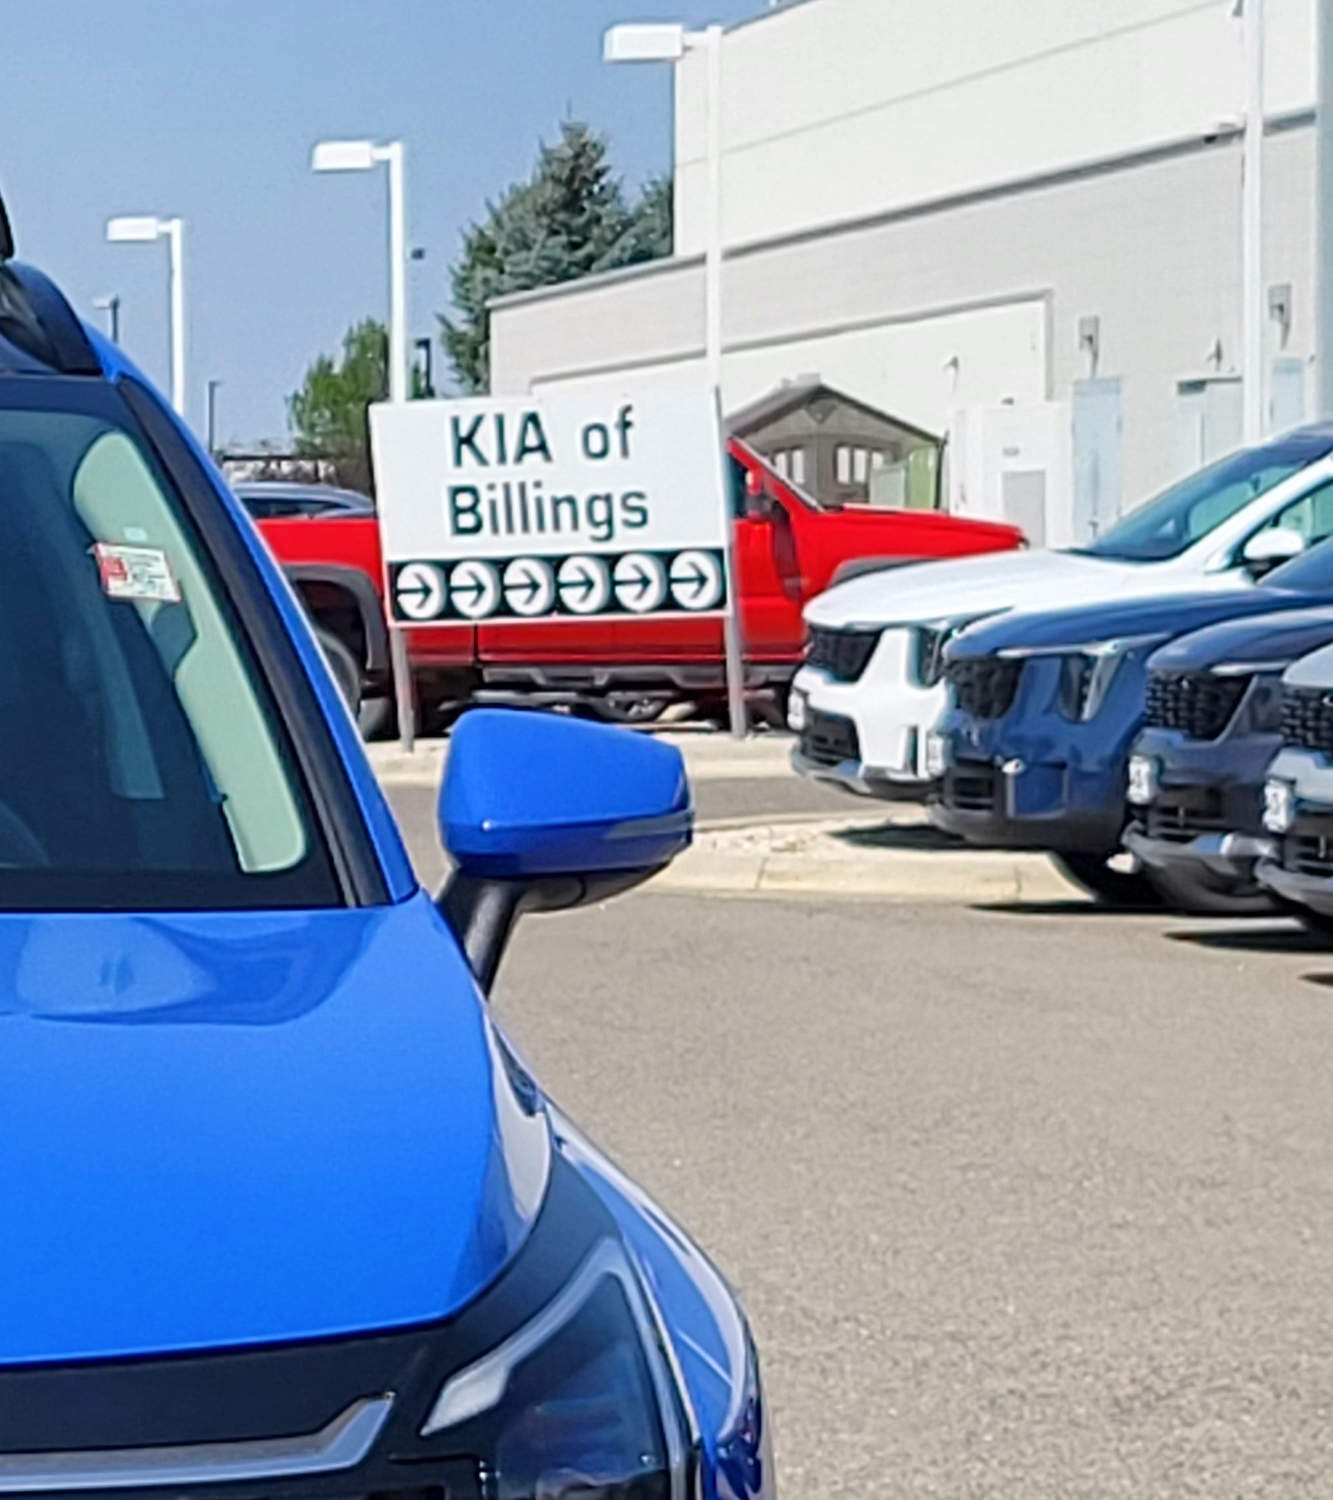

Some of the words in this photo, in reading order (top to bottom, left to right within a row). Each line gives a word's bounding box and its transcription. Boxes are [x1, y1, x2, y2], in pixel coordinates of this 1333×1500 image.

[449, 410, 552, 467] KIA
[581, 404, 634, 459] of
[448, 482, 649, 542] Billings
